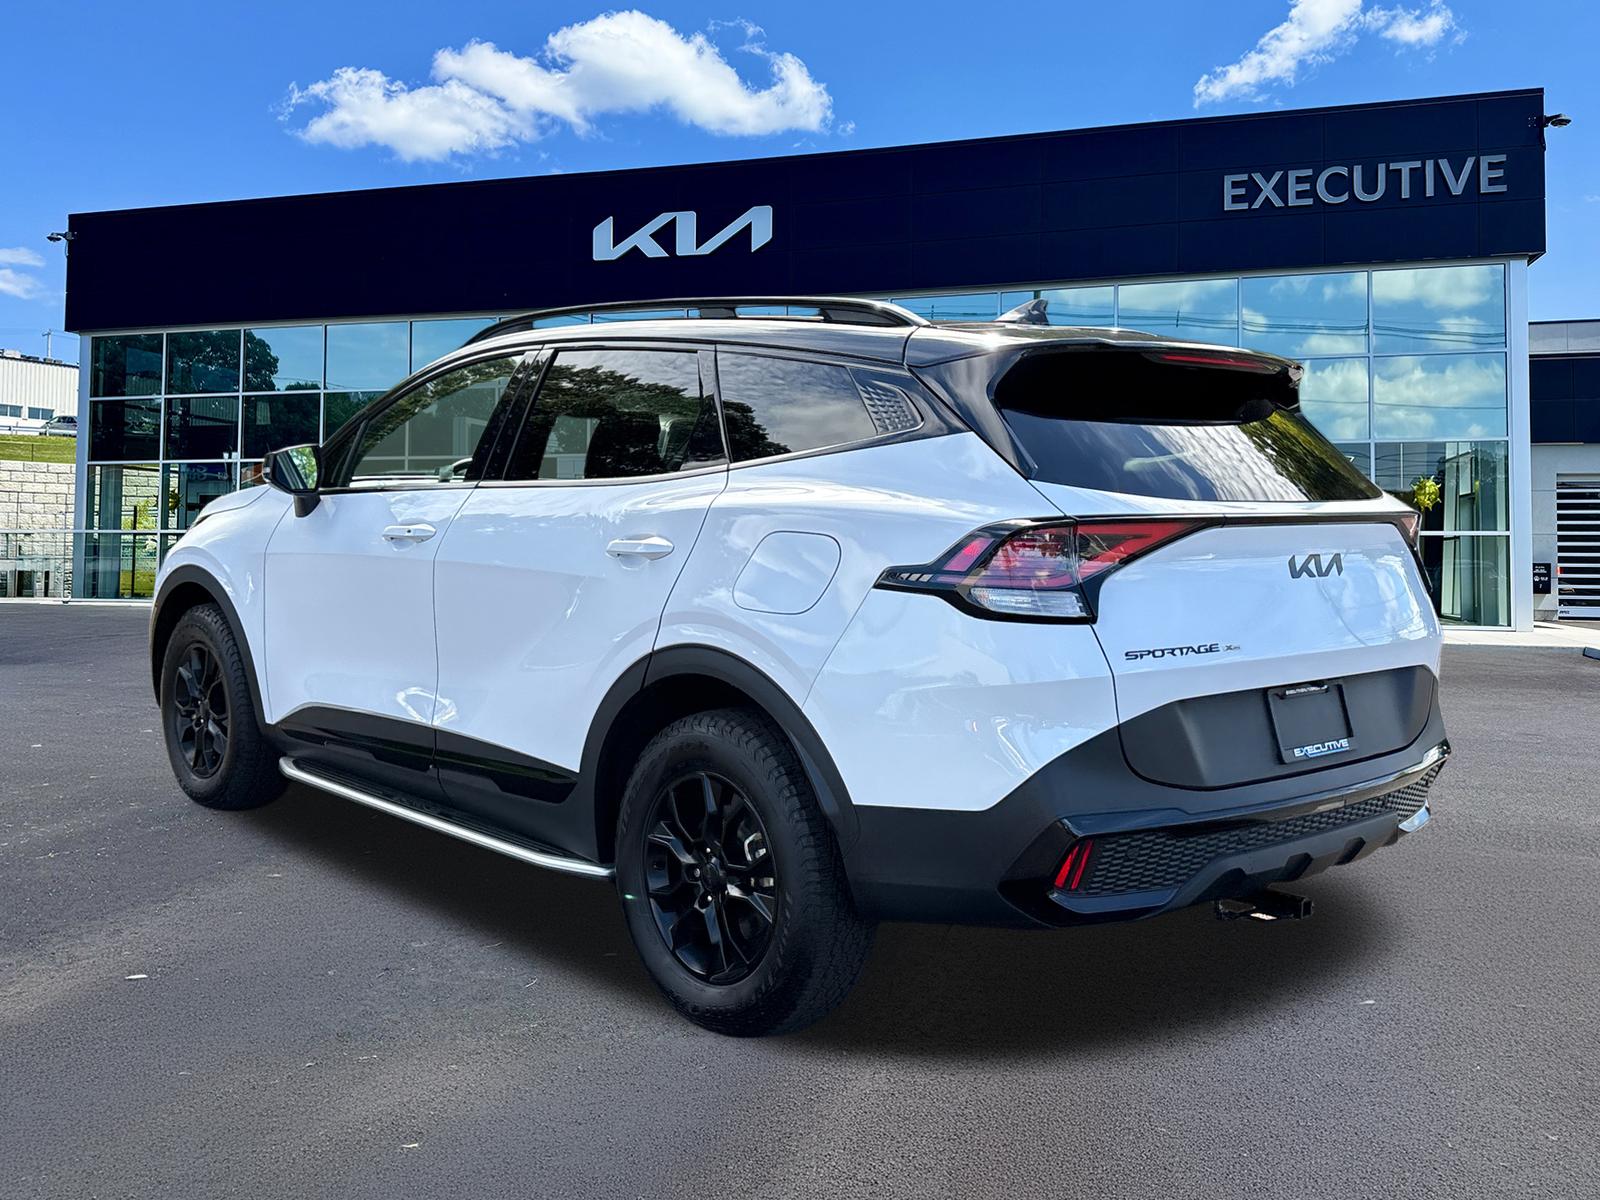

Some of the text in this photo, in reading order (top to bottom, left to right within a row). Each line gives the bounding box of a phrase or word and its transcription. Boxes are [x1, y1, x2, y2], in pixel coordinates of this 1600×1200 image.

[1223, 154, 1508, 211] EXECUTIVE
[593, 205, 772, 261] KIA
[1288, 553, 1343, 579] KIA
[1124, 643, 1220, 660] SPORTAGE
[1294, 739, 1349, 757] EXECUTIVE
